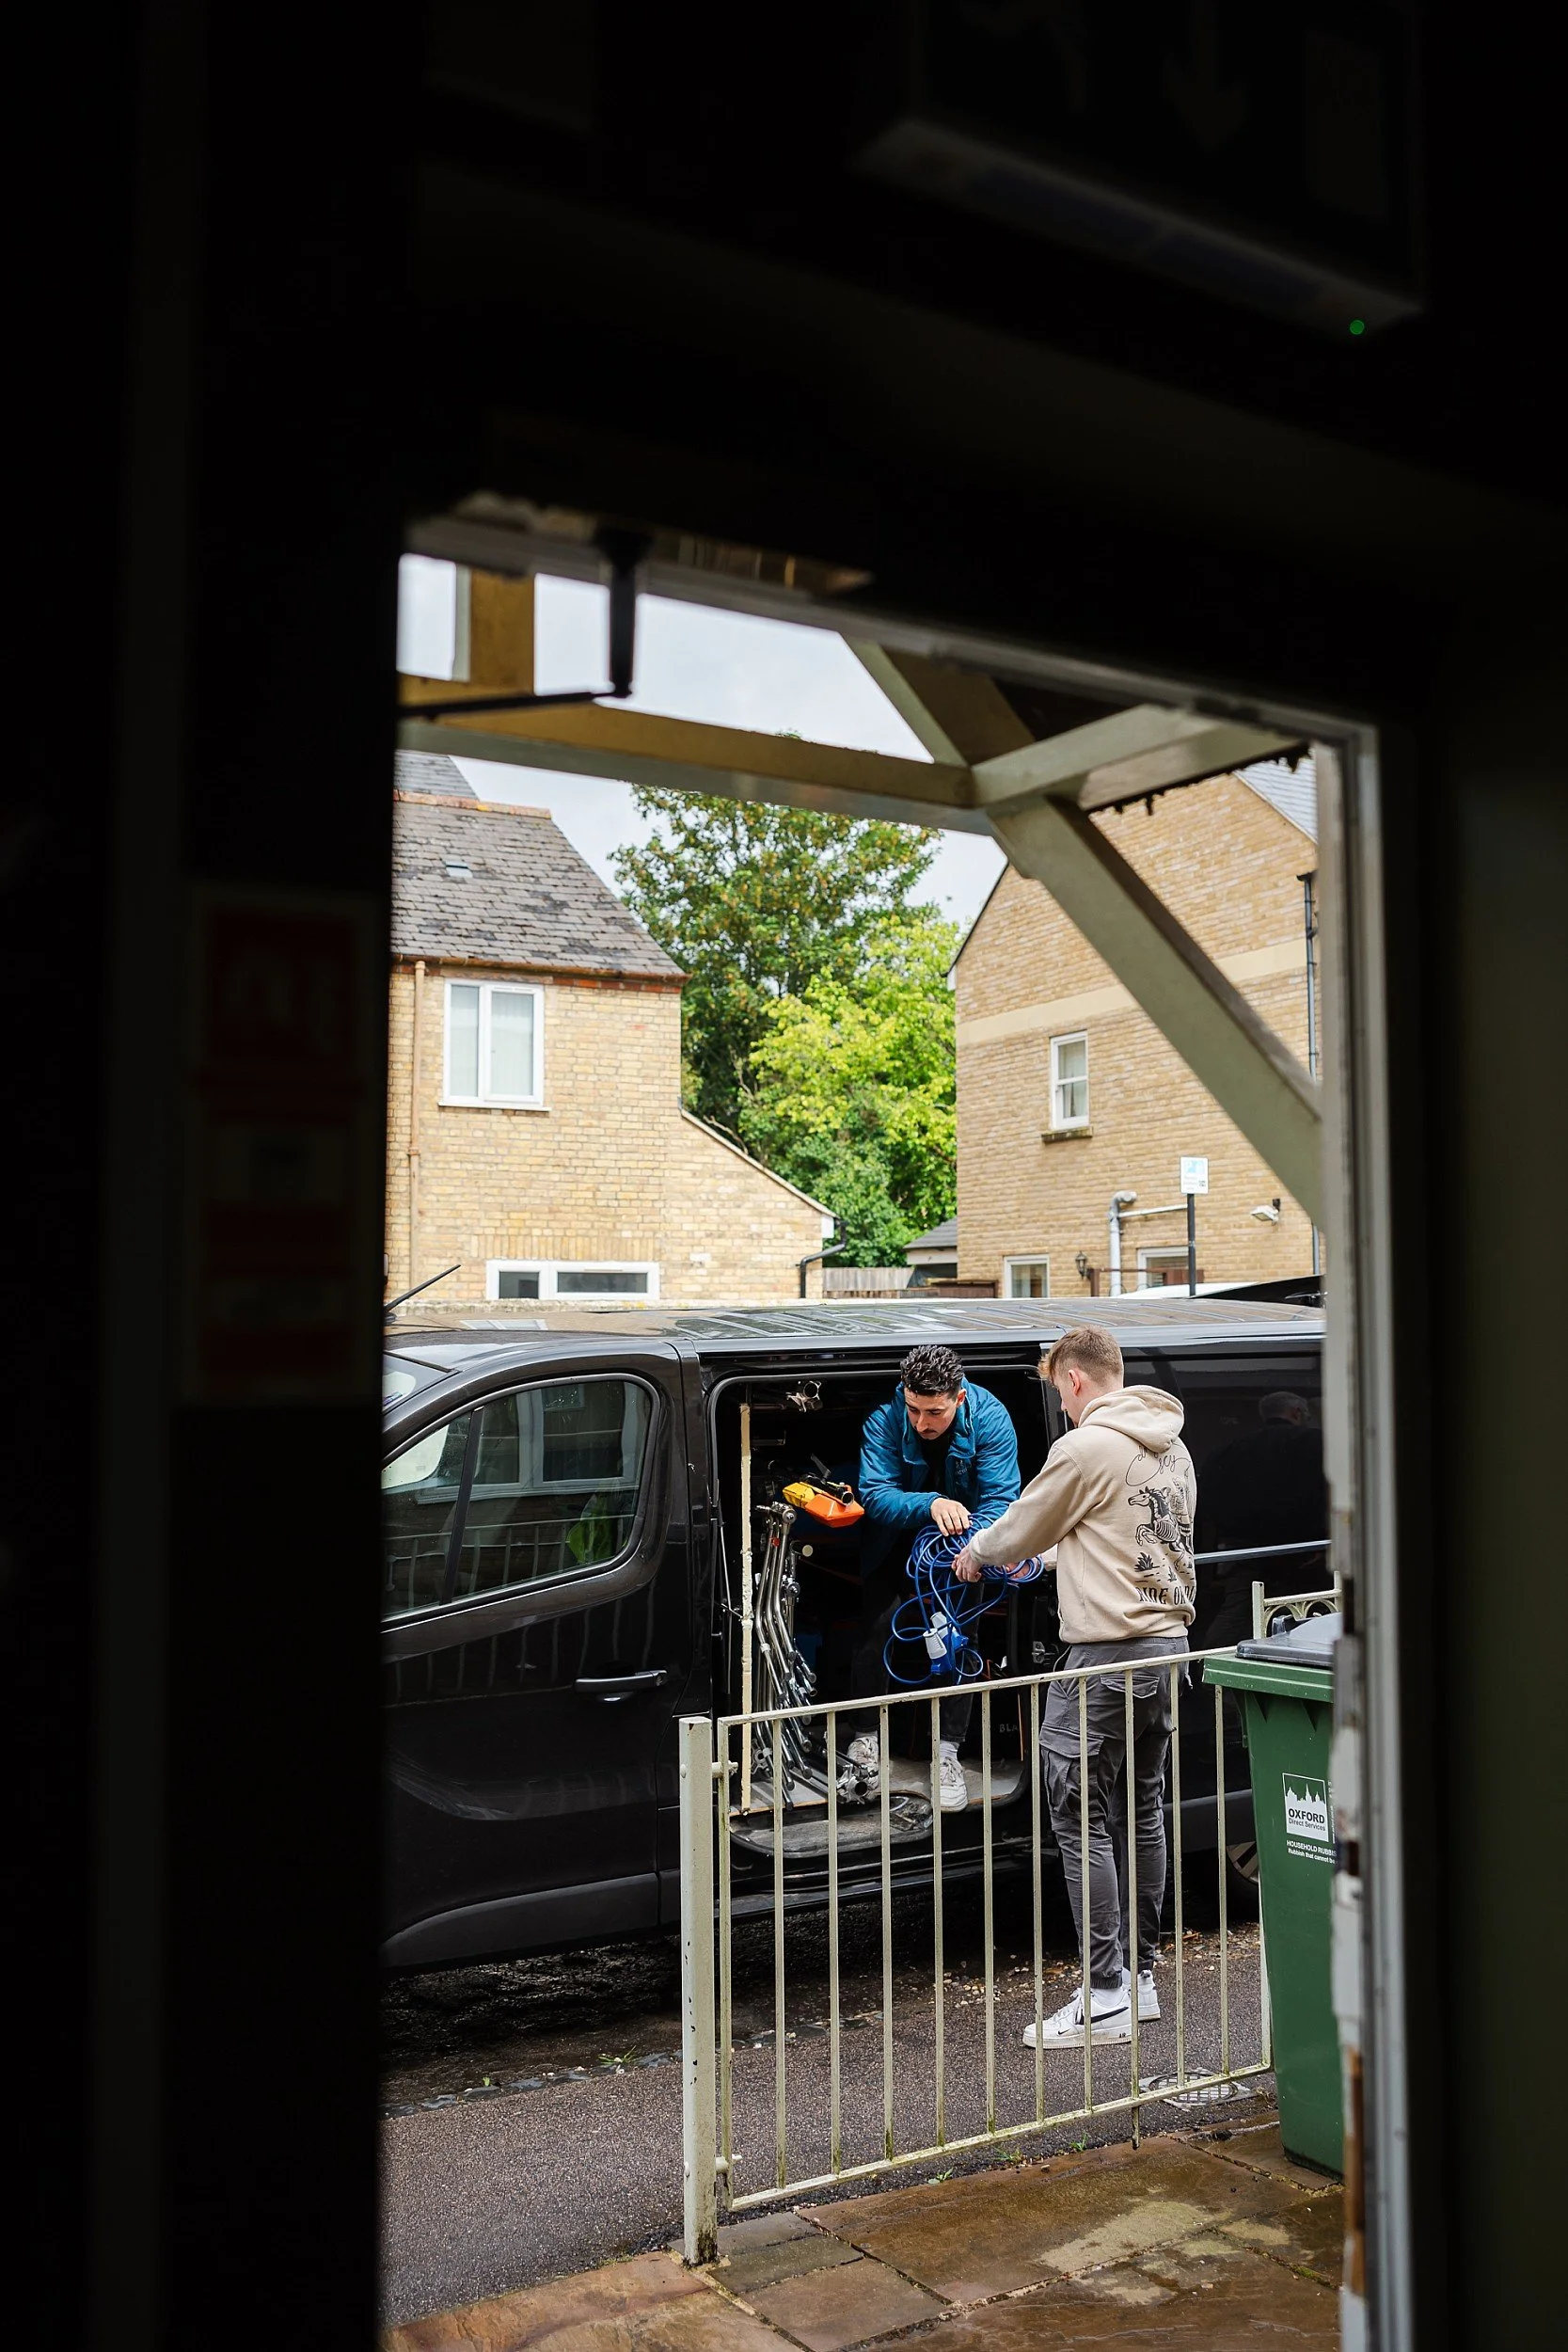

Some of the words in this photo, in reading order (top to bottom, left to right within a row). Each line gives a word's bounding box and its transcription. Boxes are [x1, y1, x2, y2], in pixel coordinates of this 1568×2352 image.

[1288, 1808, 1325, 1824] OXFORD
[1288, 1818, 1304, 1826] Direct
[1305, 1821, 1326, 1831] Services
[1287, 1840, 1318, 1852] HOUSEHOLD
